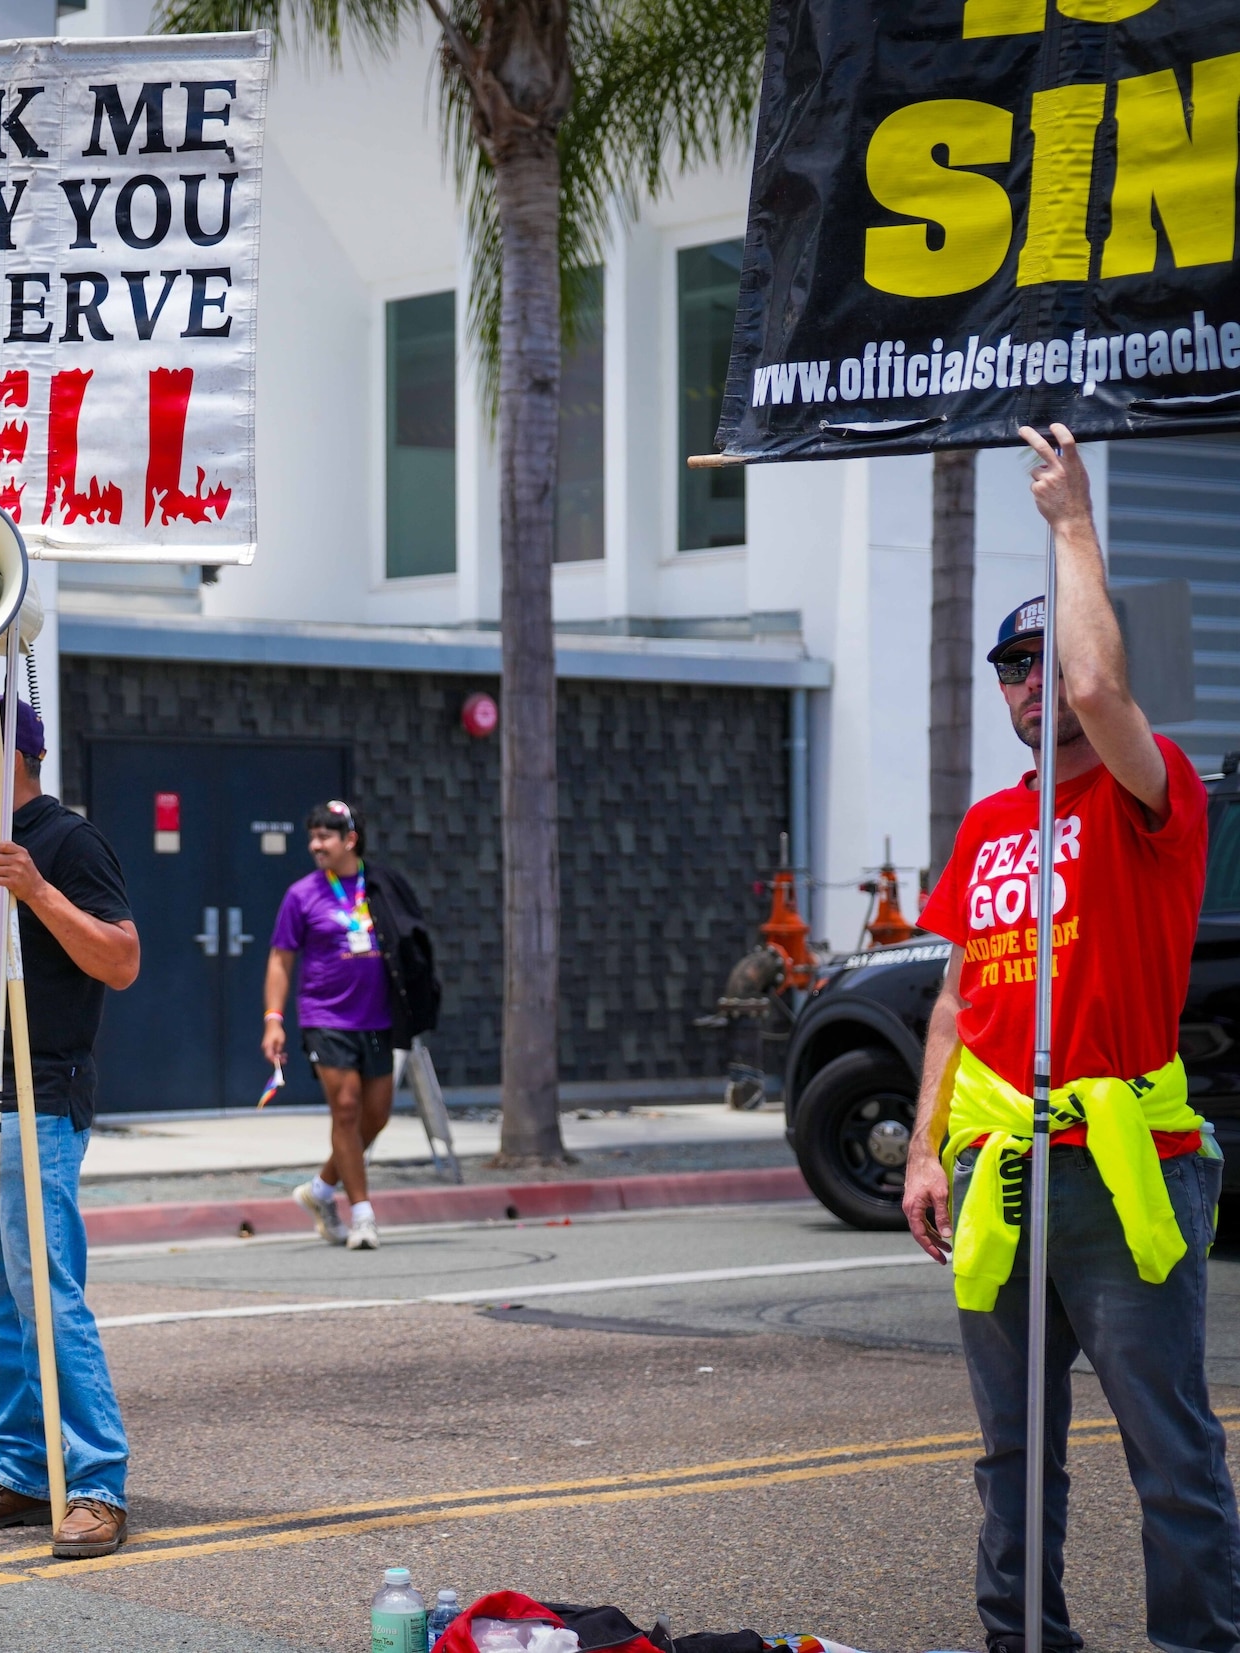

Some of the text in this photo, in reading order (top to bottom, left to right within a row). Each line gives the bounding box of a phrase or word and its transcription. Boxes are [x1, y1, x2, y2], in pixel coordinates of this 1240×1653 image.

[82, 80, 237, 163] ME
[58, 172, 238, 250] YOU
[968, 815, 1082, 888] FEAR
[970, 871, 1067, 930] GOD
[990, 930, 1020, 958] GIVE
[1025, 915, 1079, 951] GORY
[981, 962, 999, 987] TO
